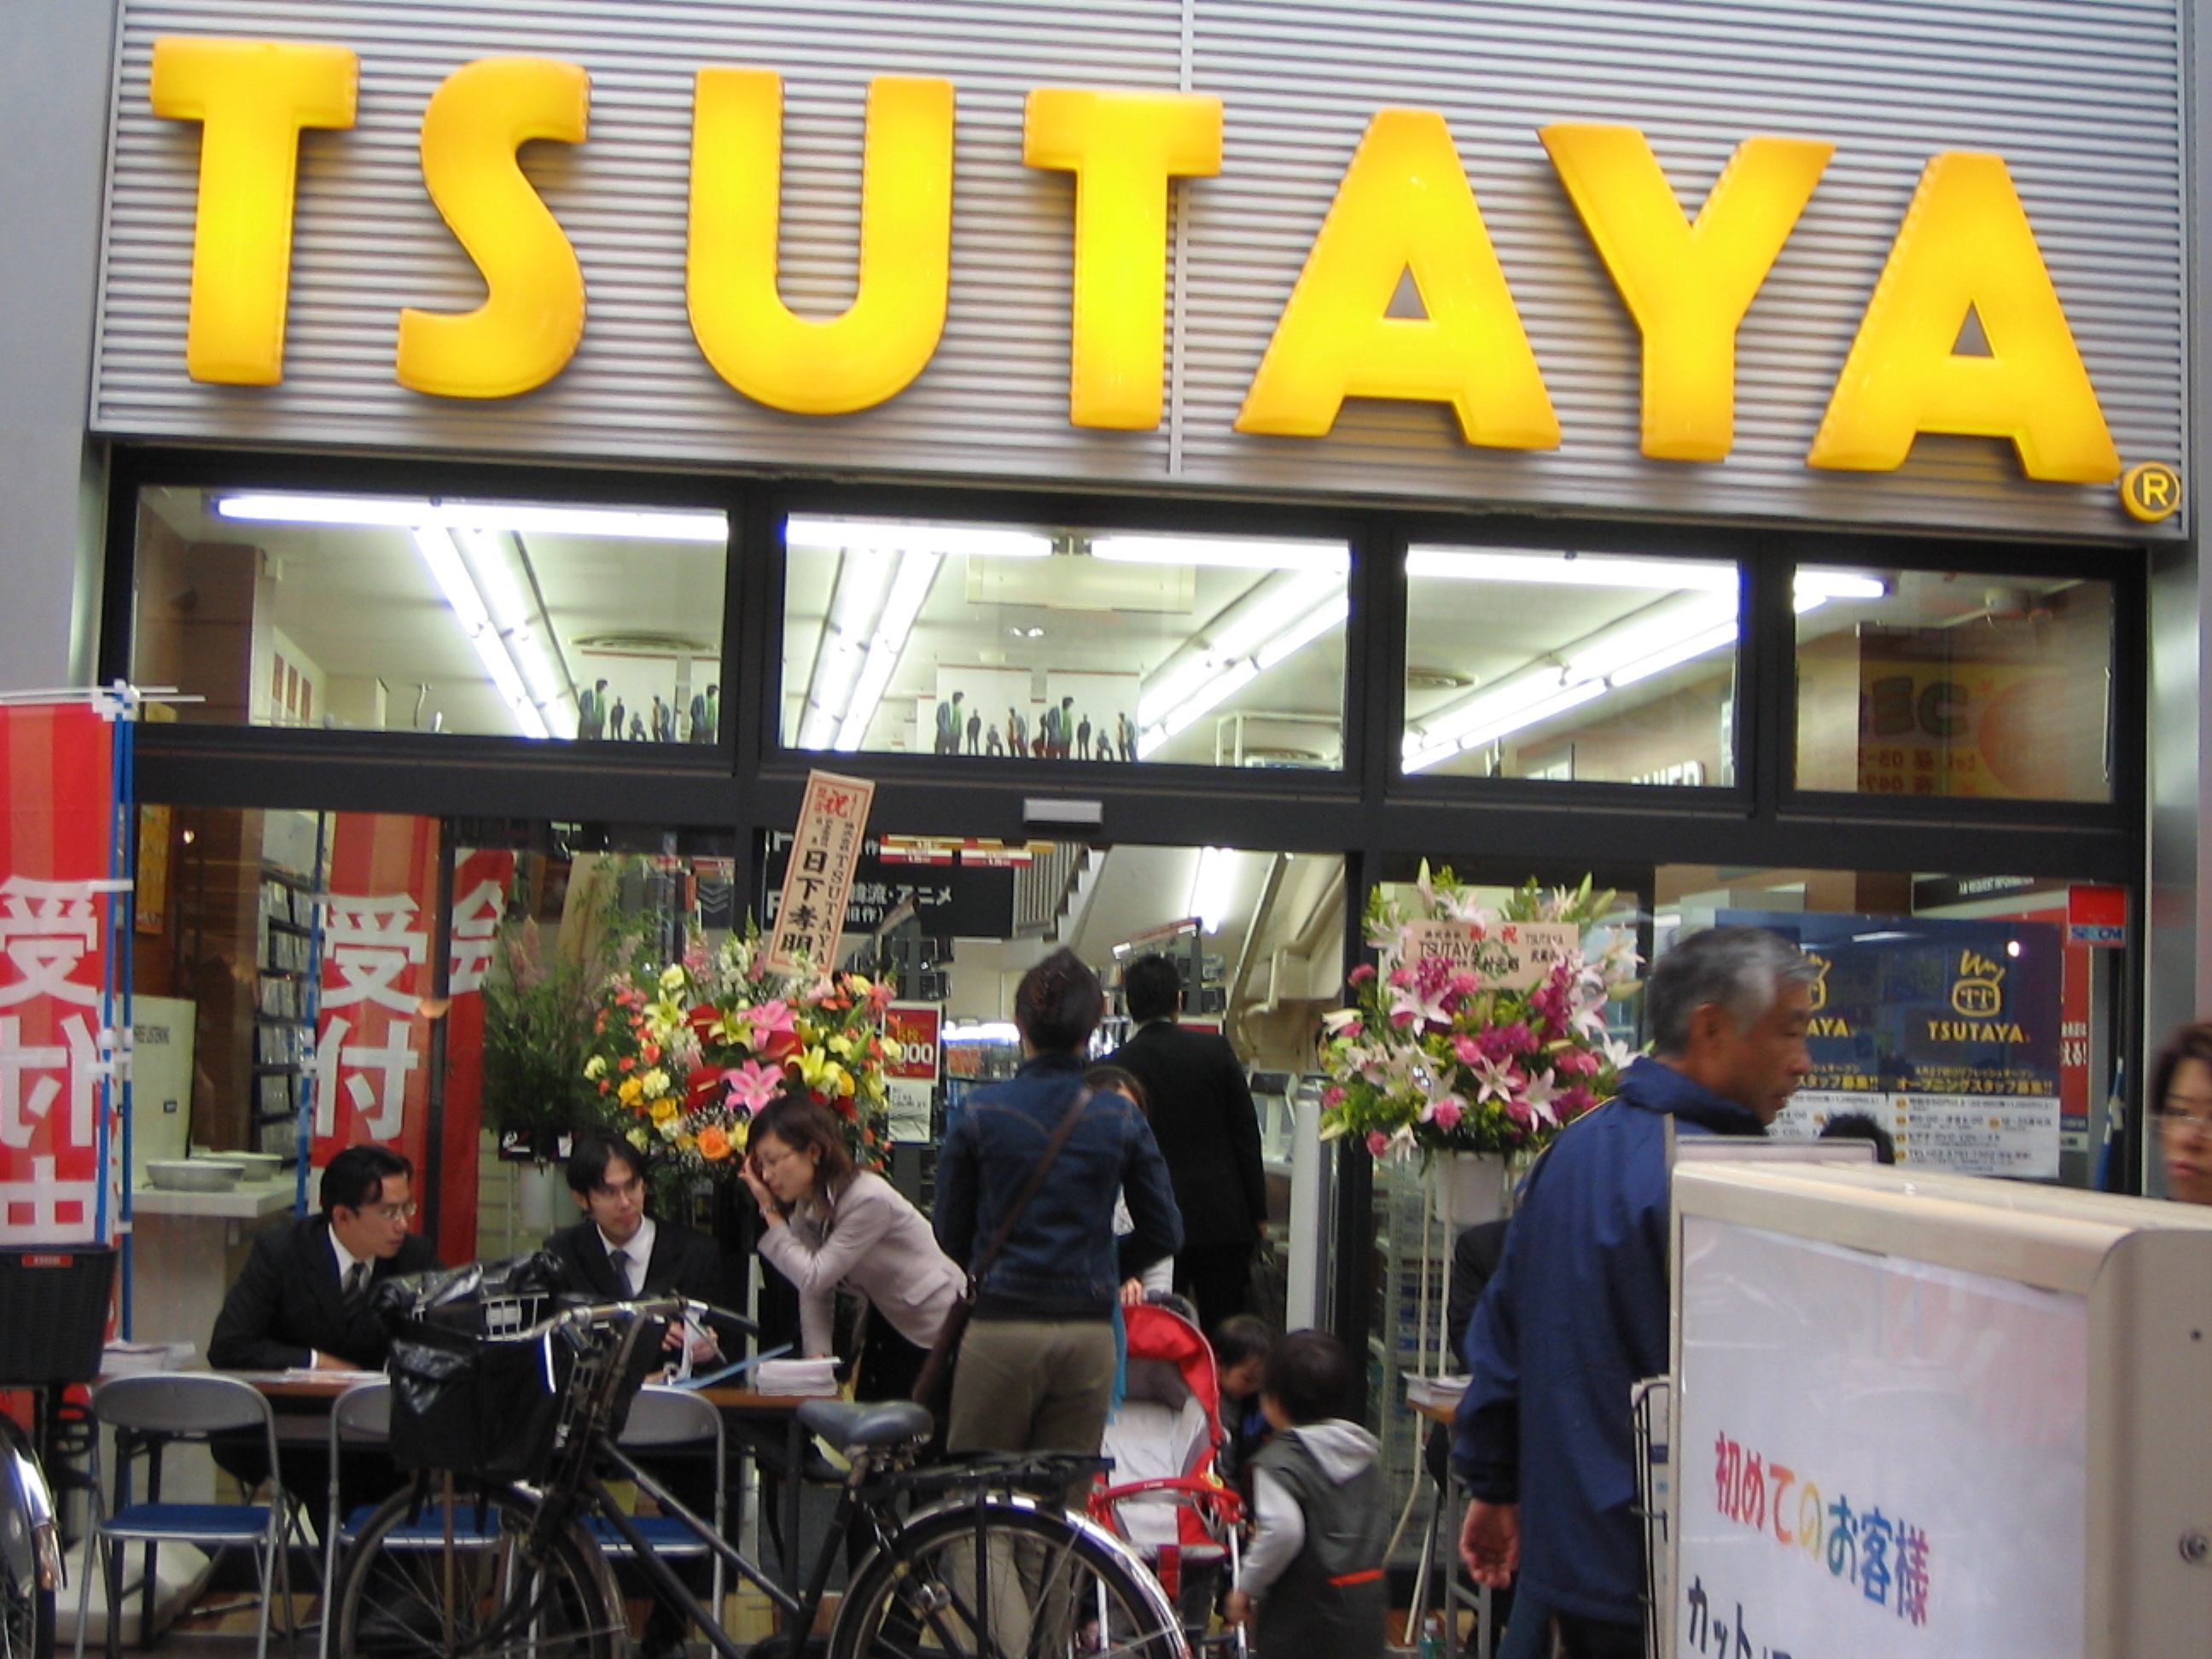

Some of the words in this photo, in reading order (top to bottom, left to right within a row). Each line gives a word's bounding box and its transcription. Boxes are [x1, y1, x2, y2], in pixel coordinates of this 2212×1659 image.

[150, 36, 2123, 484] TSUTAYA
[307, 893, 428, 1214] 受付
[1927, 1021, 2027, 1043] TSUTAYA
[1688, 1575, 1793, 1659] カット
[1714, 1430, 1929, 1627] 初めてのお客様
